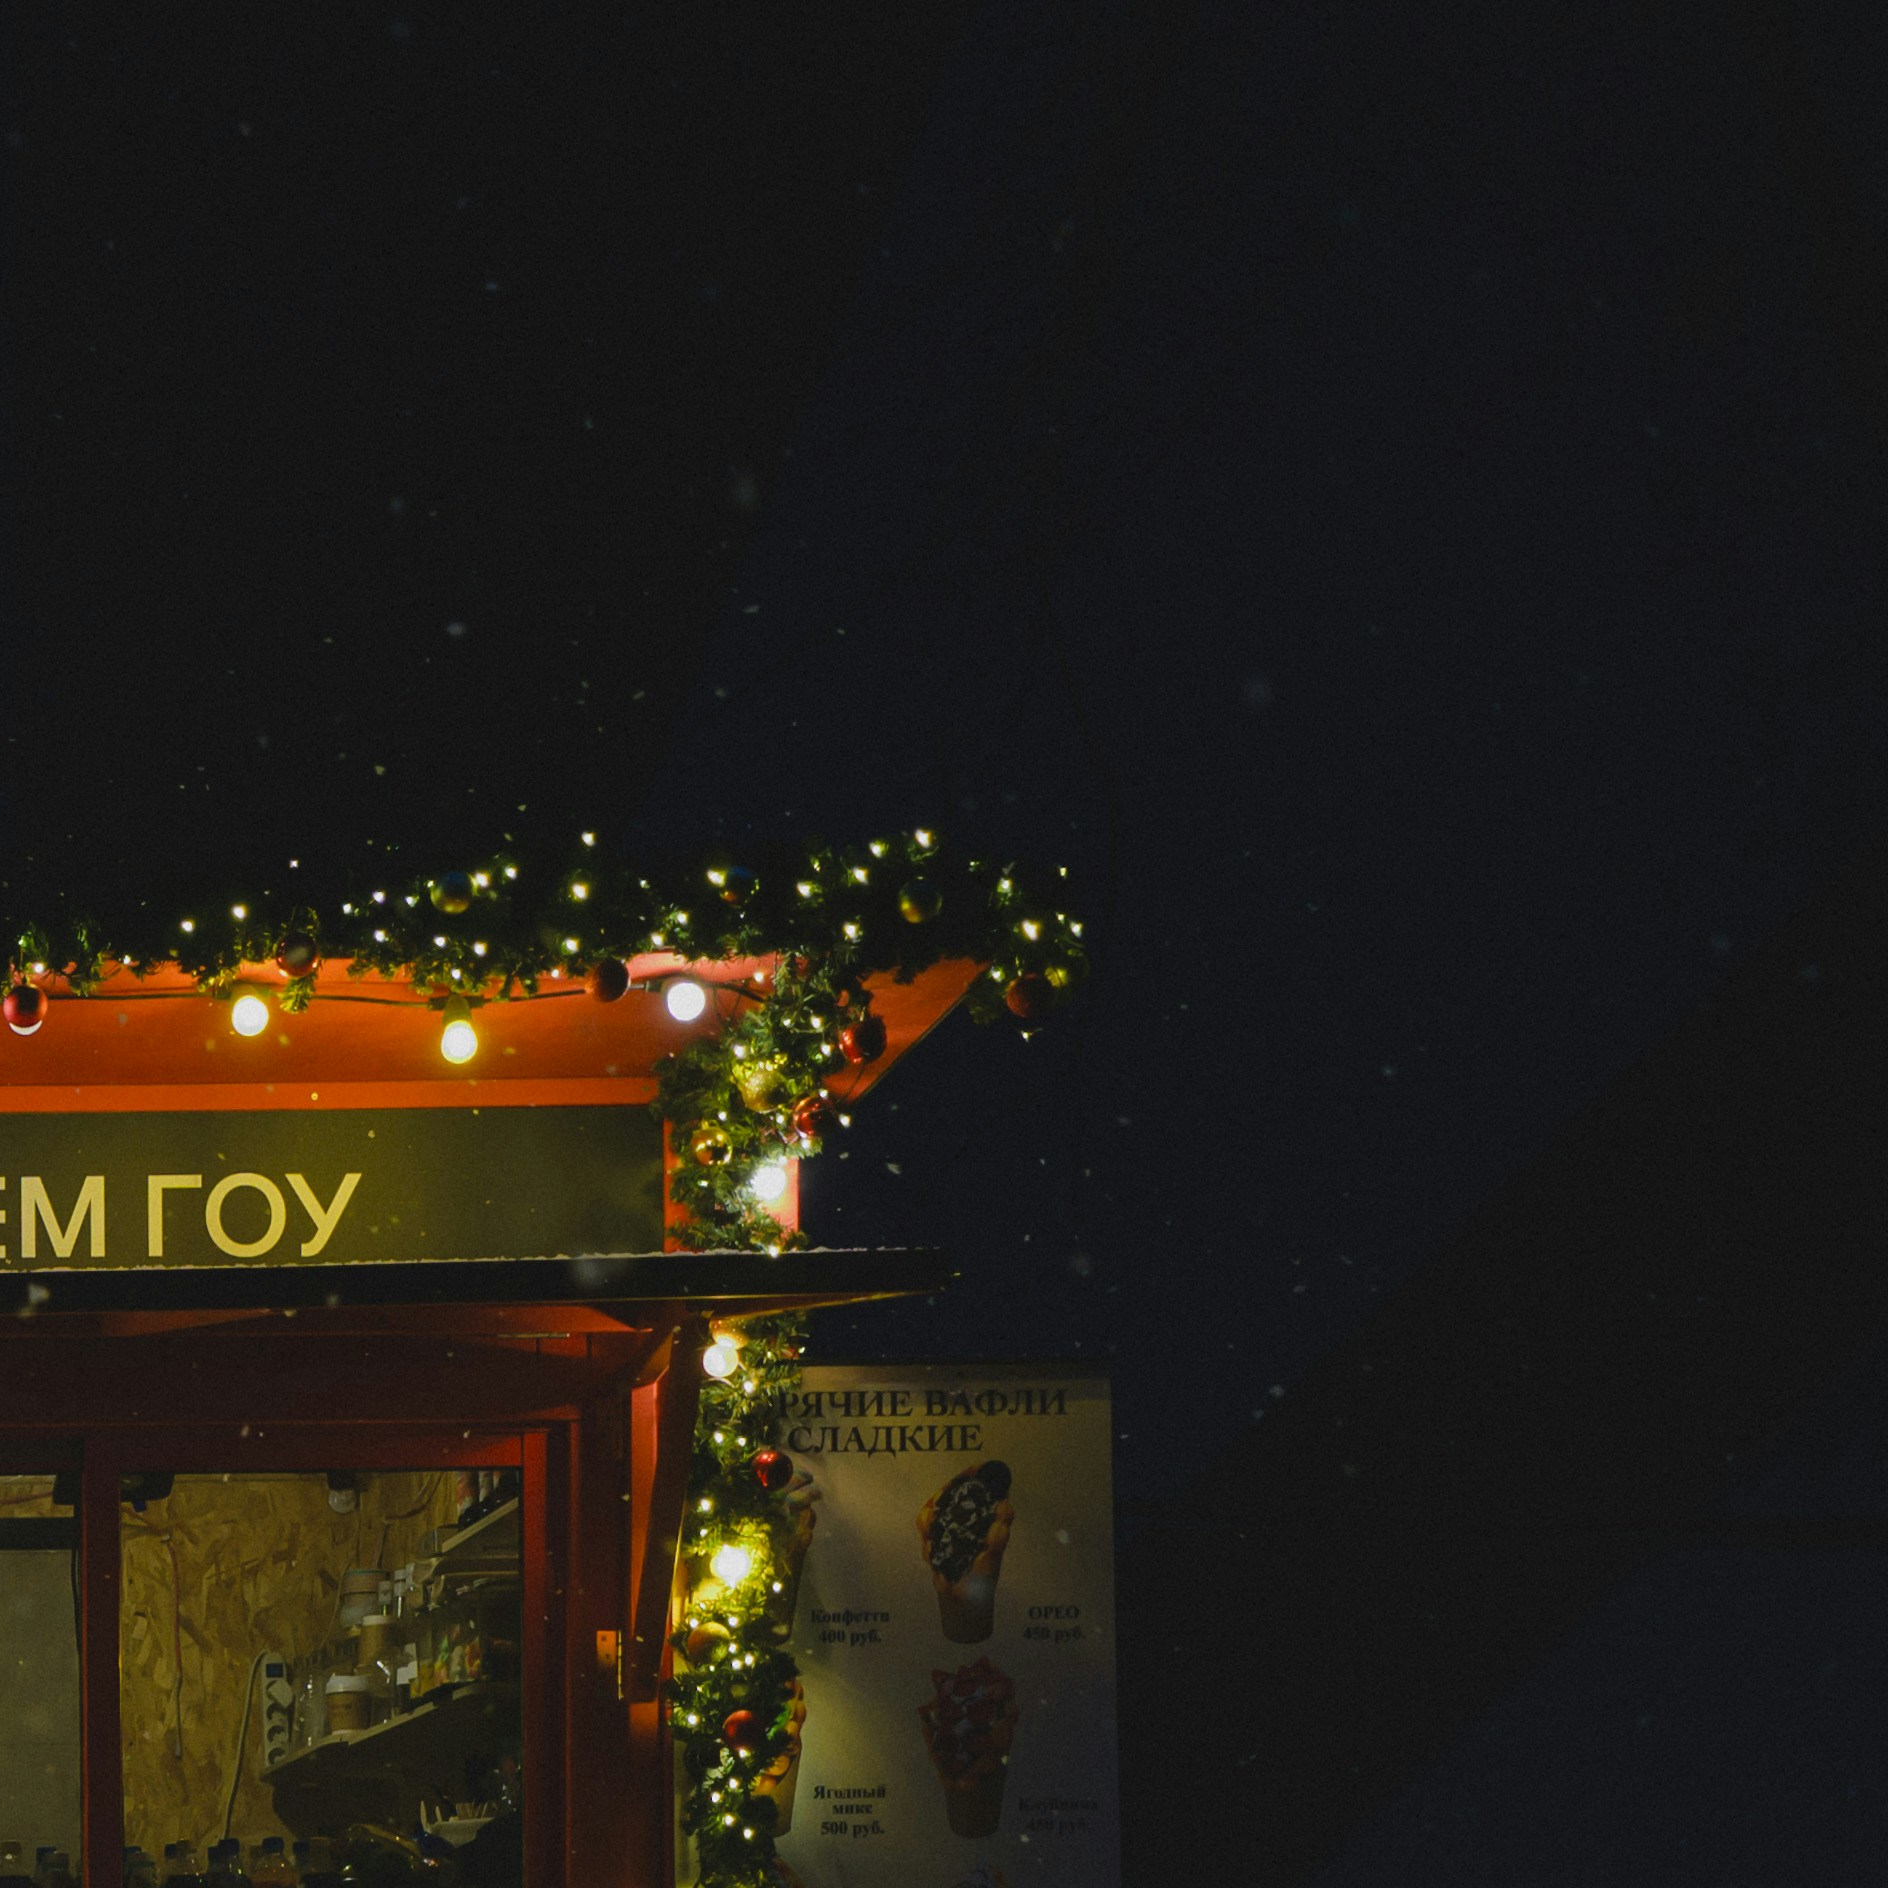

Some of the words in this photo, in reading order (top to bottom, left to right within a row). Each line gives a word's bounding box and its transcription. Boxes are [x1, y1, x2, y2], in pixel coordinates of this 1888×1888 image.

[147, 1172, 363, 1258] ГОУ
[778, 1389, 914, 1419] РЯЧИЕ
[923, 1388, 1069, 1417] ВАФЛИ
[787, 1424, 984, 1458] СЛАДКИЕ
